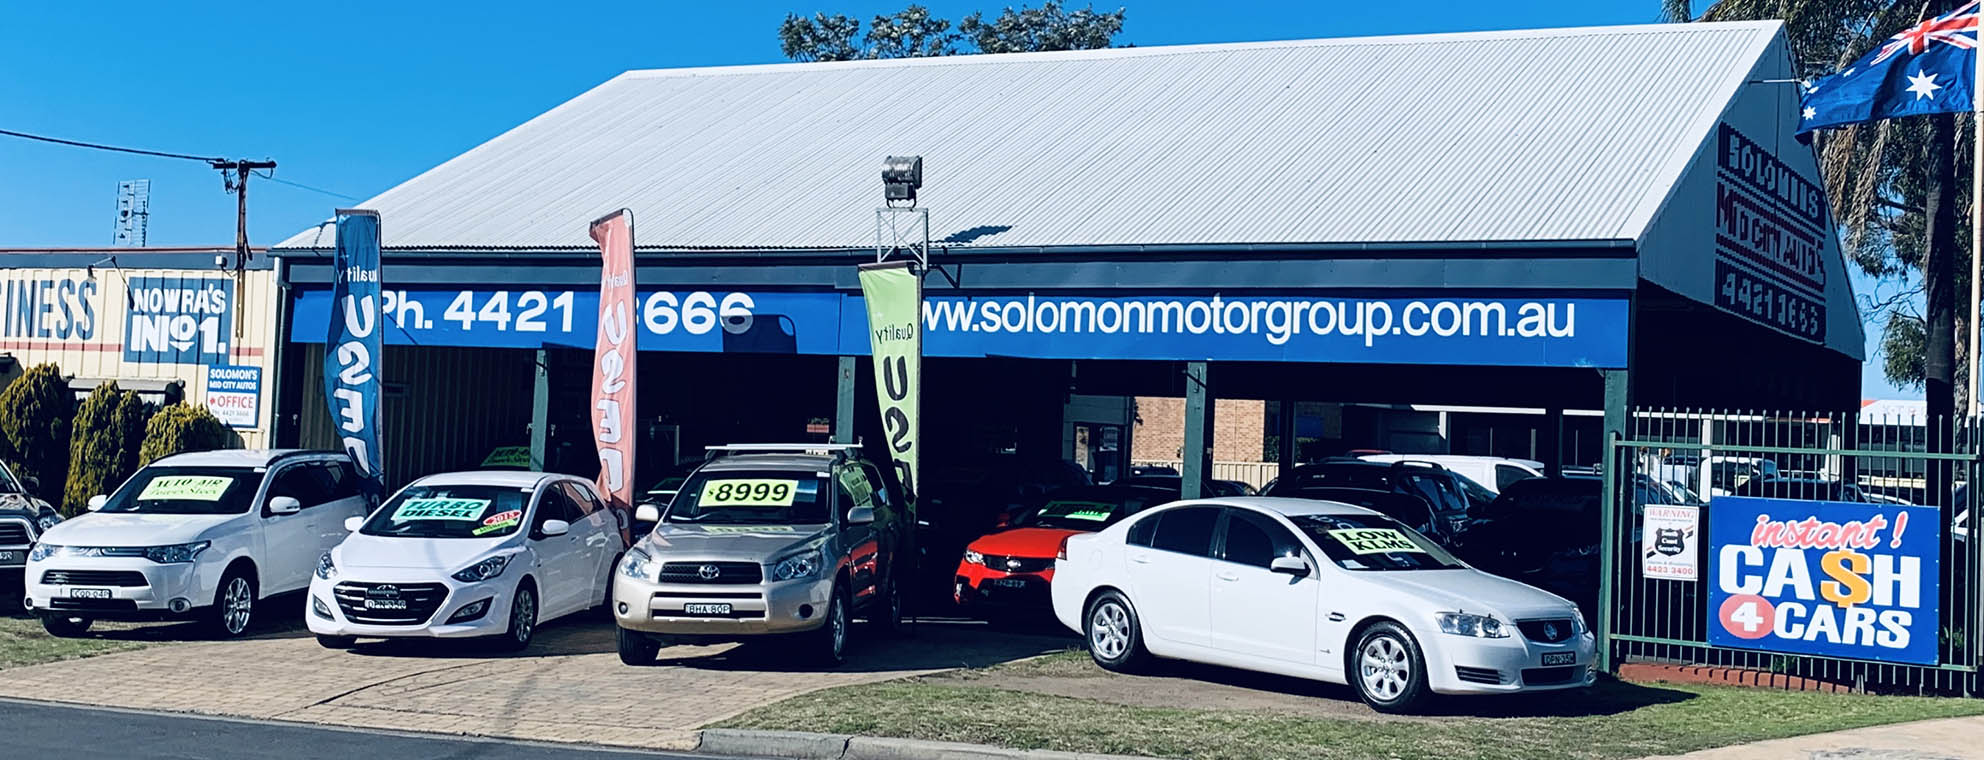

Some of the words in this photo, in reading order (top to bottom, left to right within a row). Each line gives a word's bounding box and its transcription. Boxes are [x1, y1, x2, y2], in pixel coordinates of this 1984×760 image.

[133, 284, 226, 315] NOWRA'S
[0, 278, 97, 340] INESS
[443, 290, 574, 333] 4421
[636, 291, 755, 335] 666
[921, 292, 1575, 347] ww.solomonmotorgroup.com.au
[209, 380, 221, 389] MID
[222, 381, 237, 389] CITY
[236, 381, 256, 390] AUTOS
[217, 395, 254, 409] OFFICE
[707, 483, 789, 502] $8999
[405, 500, 484, 511] TURBO
[400, 509, 473, 519] DIESEL
[1648, 508, 1695, 519] WARNING
[1338, 530, 1398, 541] LOW
[1349, 540, 1416, 551] KLMS
[1730, 601, 1764, 632] 4
[1772, 601, 1913, 650] CARS
